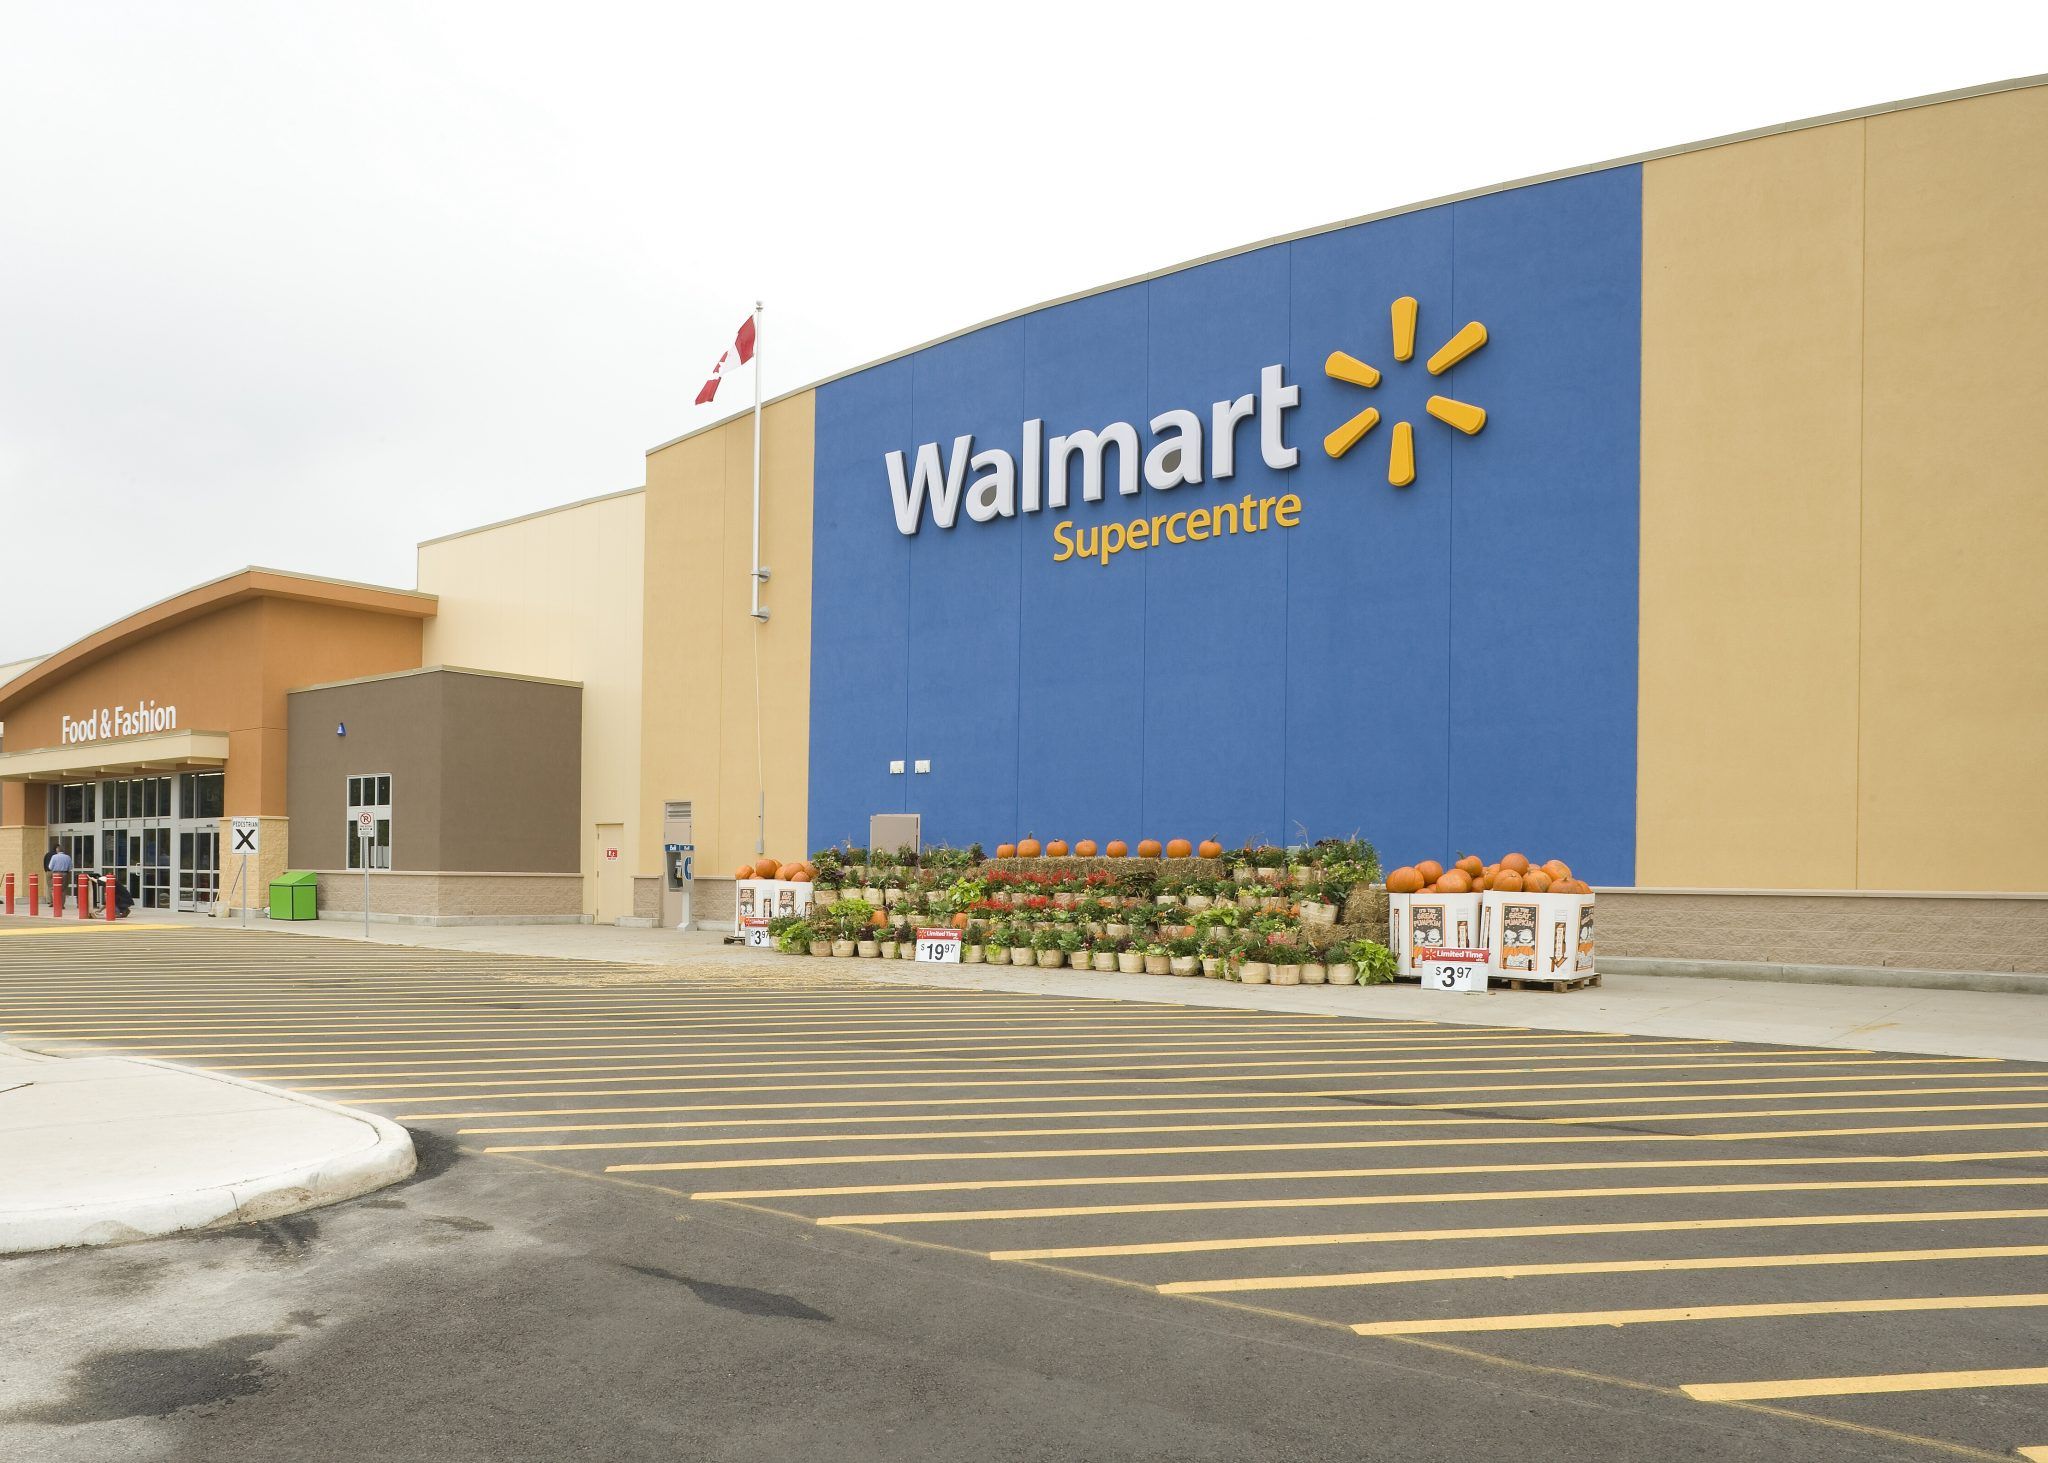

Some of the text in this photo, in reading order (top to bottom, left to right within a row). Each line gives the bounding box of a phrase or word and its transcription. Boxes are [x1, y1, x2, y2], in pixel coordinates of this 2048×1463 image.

[885, 364, 1300, 535] Walmart
[1053, 493, 1302, 565] Supercentre
[62, 700, 176, 744] Food & Fashion
[235, 829, 256, 850] X
[1416, 912, 1438, 920] GREAT
[1509, 912, 1532, 920] GREAT
[1414, 919, 1441, 928] PUMPKIN
[1505, 919, 1535, 928] PUMPKIN
[1436, 950, 1484, 959] Limited Time
